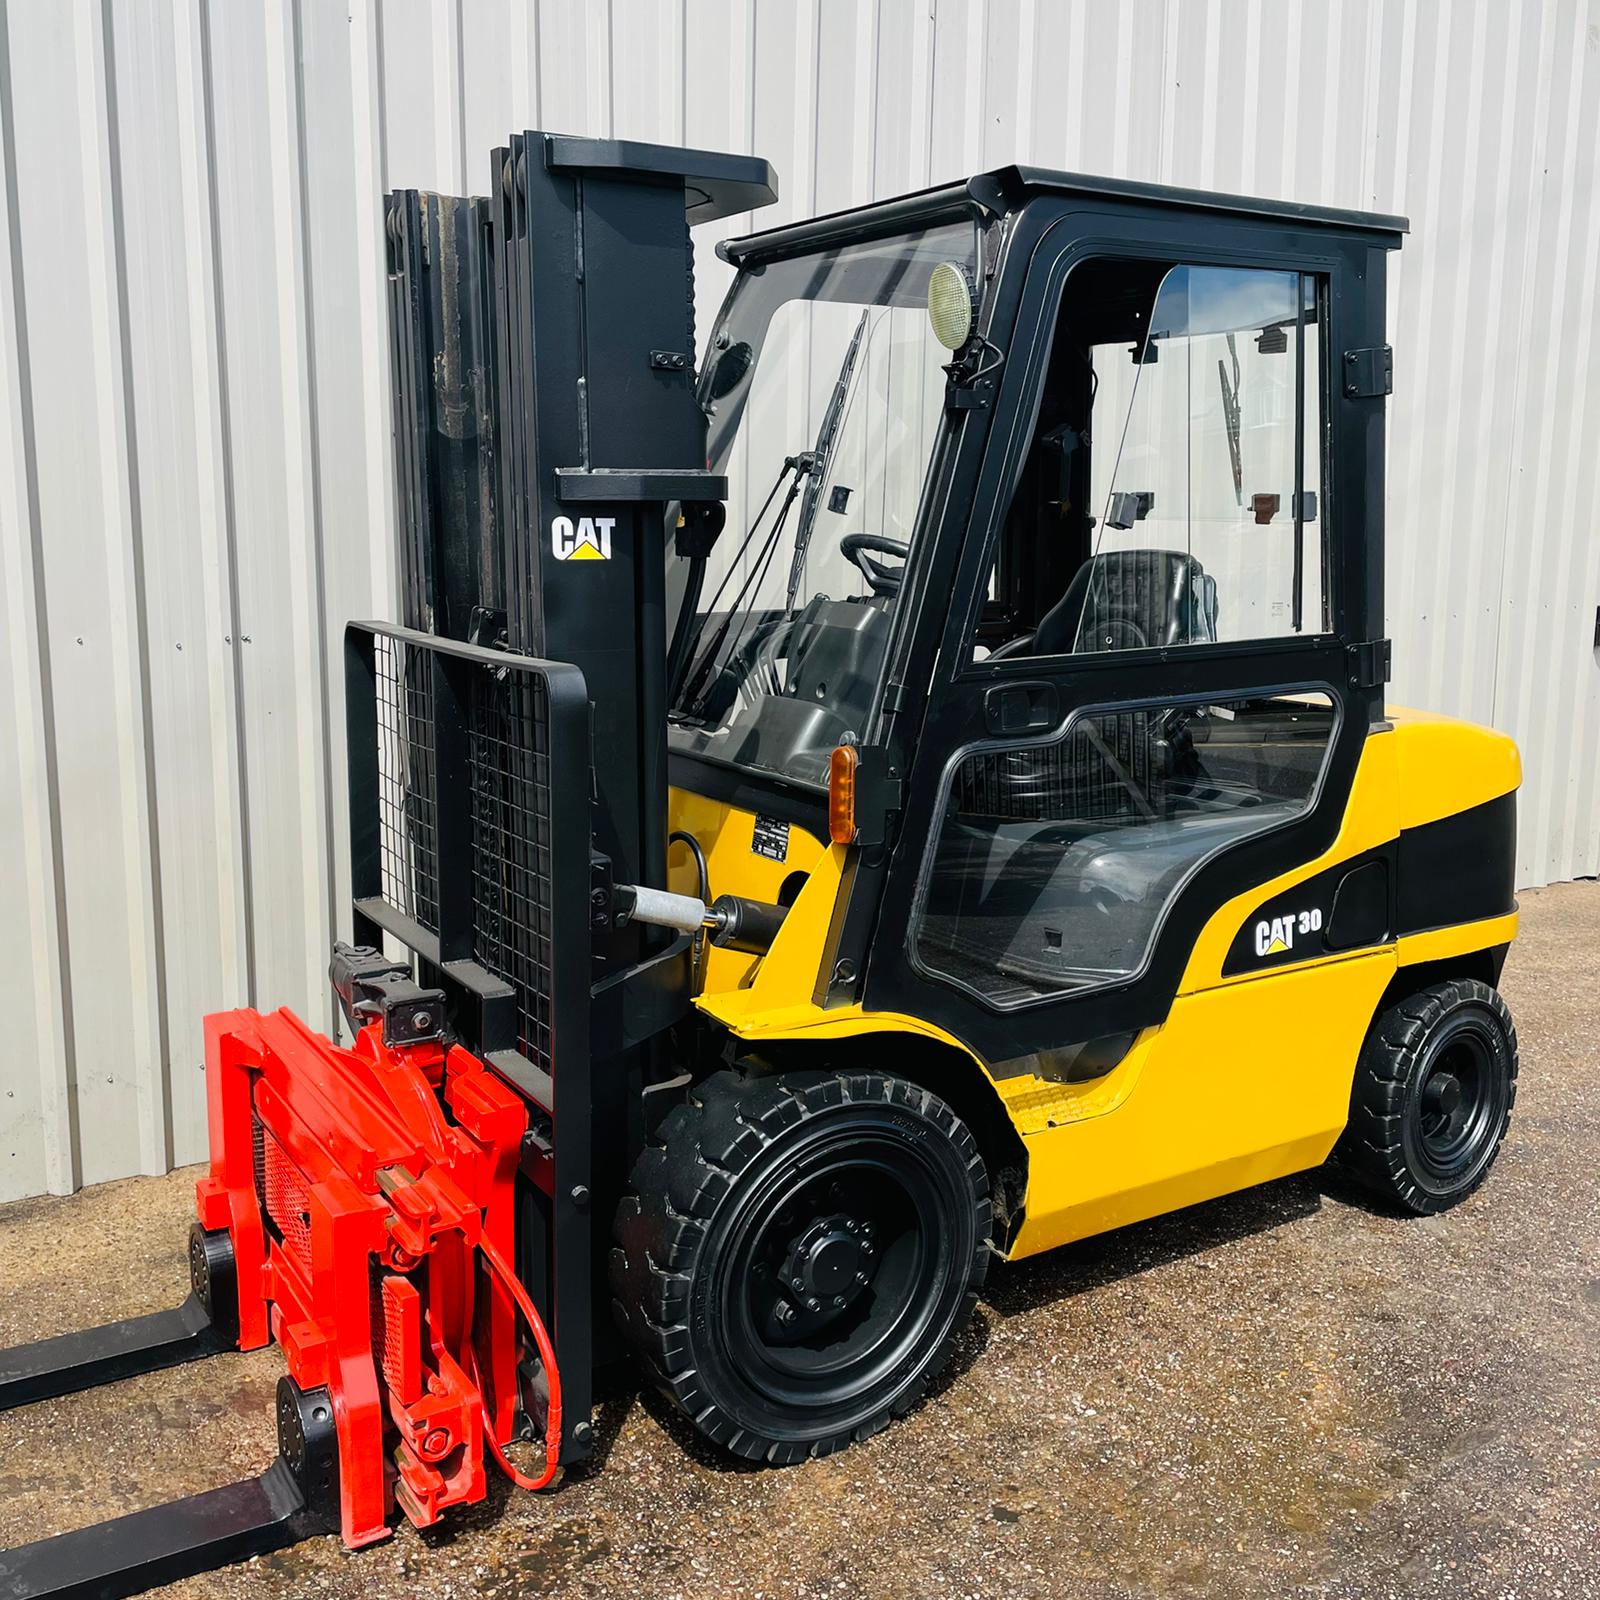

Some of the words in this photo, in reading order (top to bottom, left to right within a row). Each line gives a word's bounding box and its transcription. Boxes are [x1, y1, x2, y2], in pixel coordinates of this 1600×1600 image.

[551, 516, 616, 560] CAT
[1255, 914, 1296, 957] CAT
[1298, 908, 1322, 934] 30
